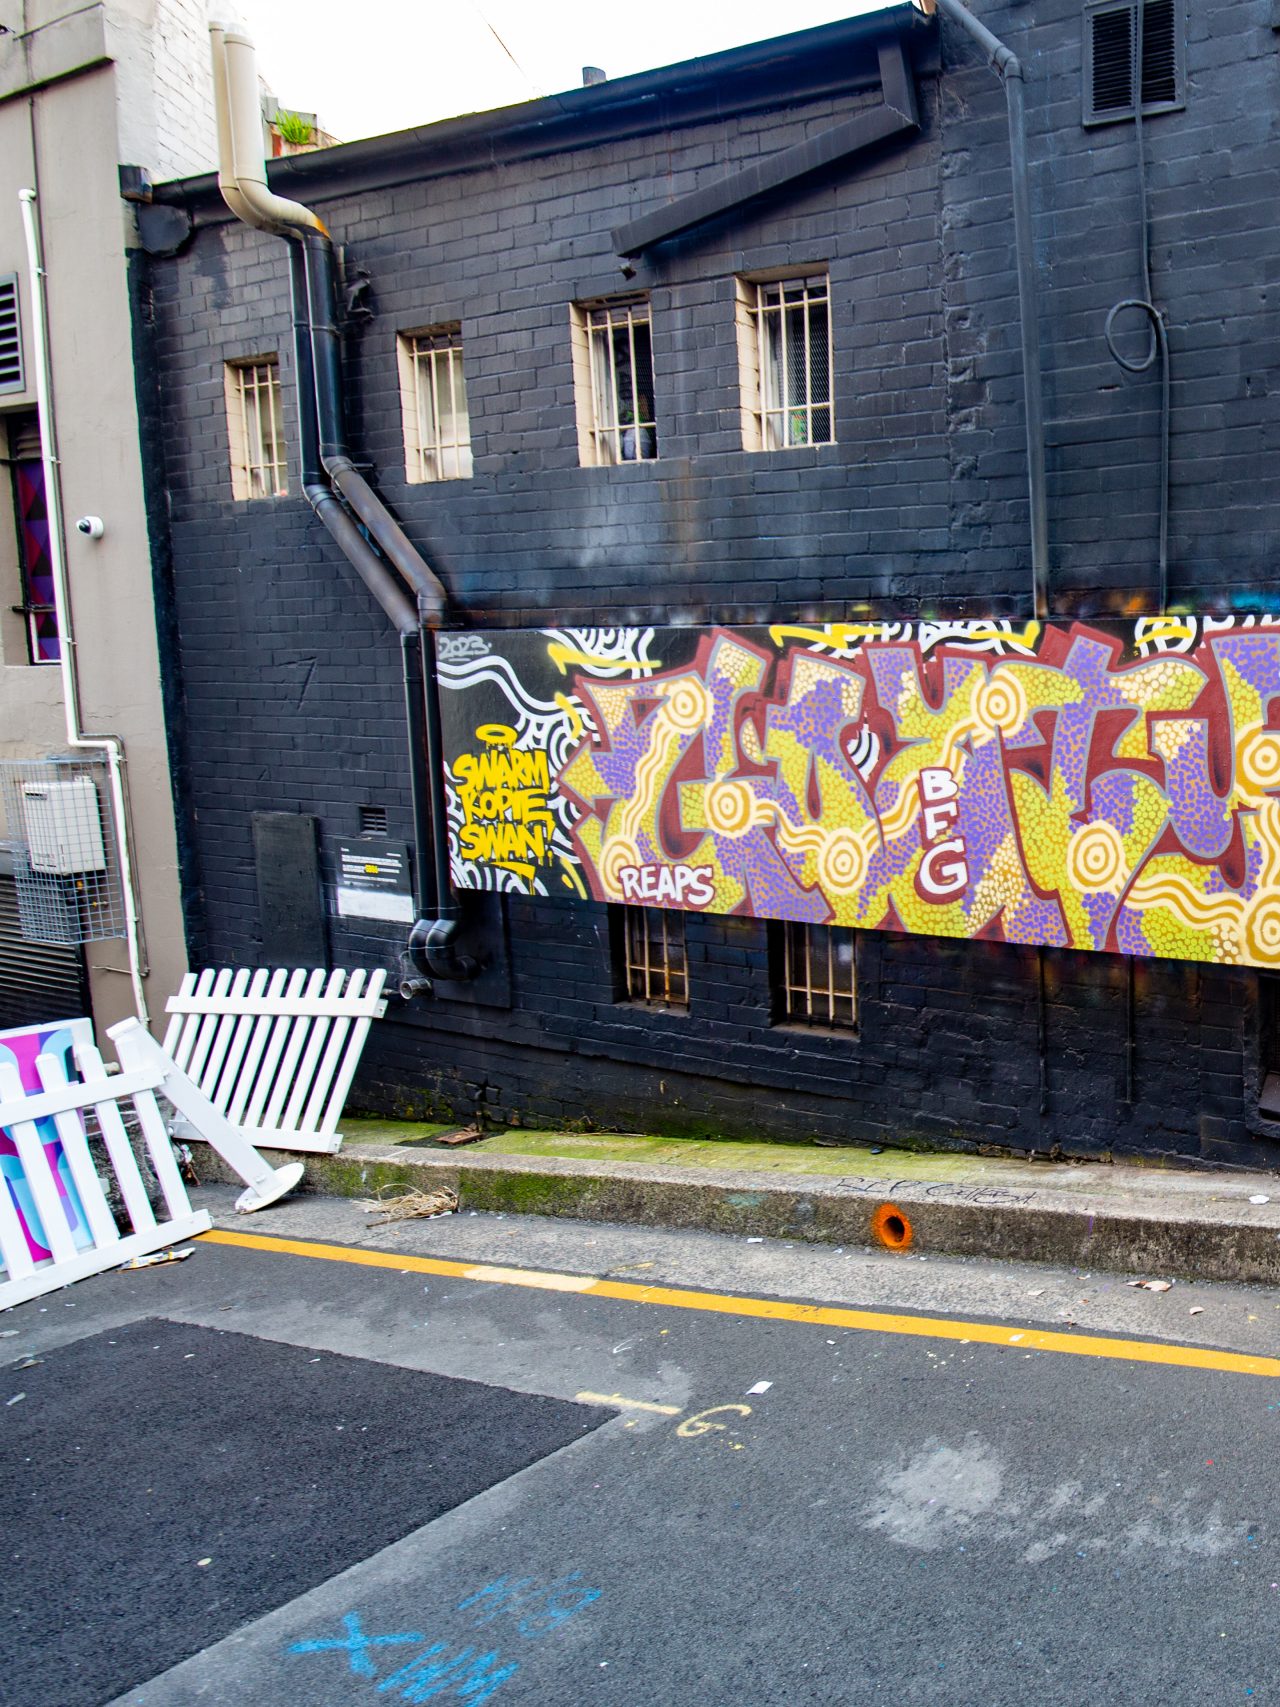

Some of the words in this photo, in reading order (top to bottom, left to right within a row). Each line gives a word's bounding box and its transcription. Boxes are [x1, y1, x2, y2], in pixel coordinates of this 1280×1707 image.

[438, 635, 490, 660] 2023
[452, 749, 550, 796] SWARM
[619, 865, 715, 905] REAPS
